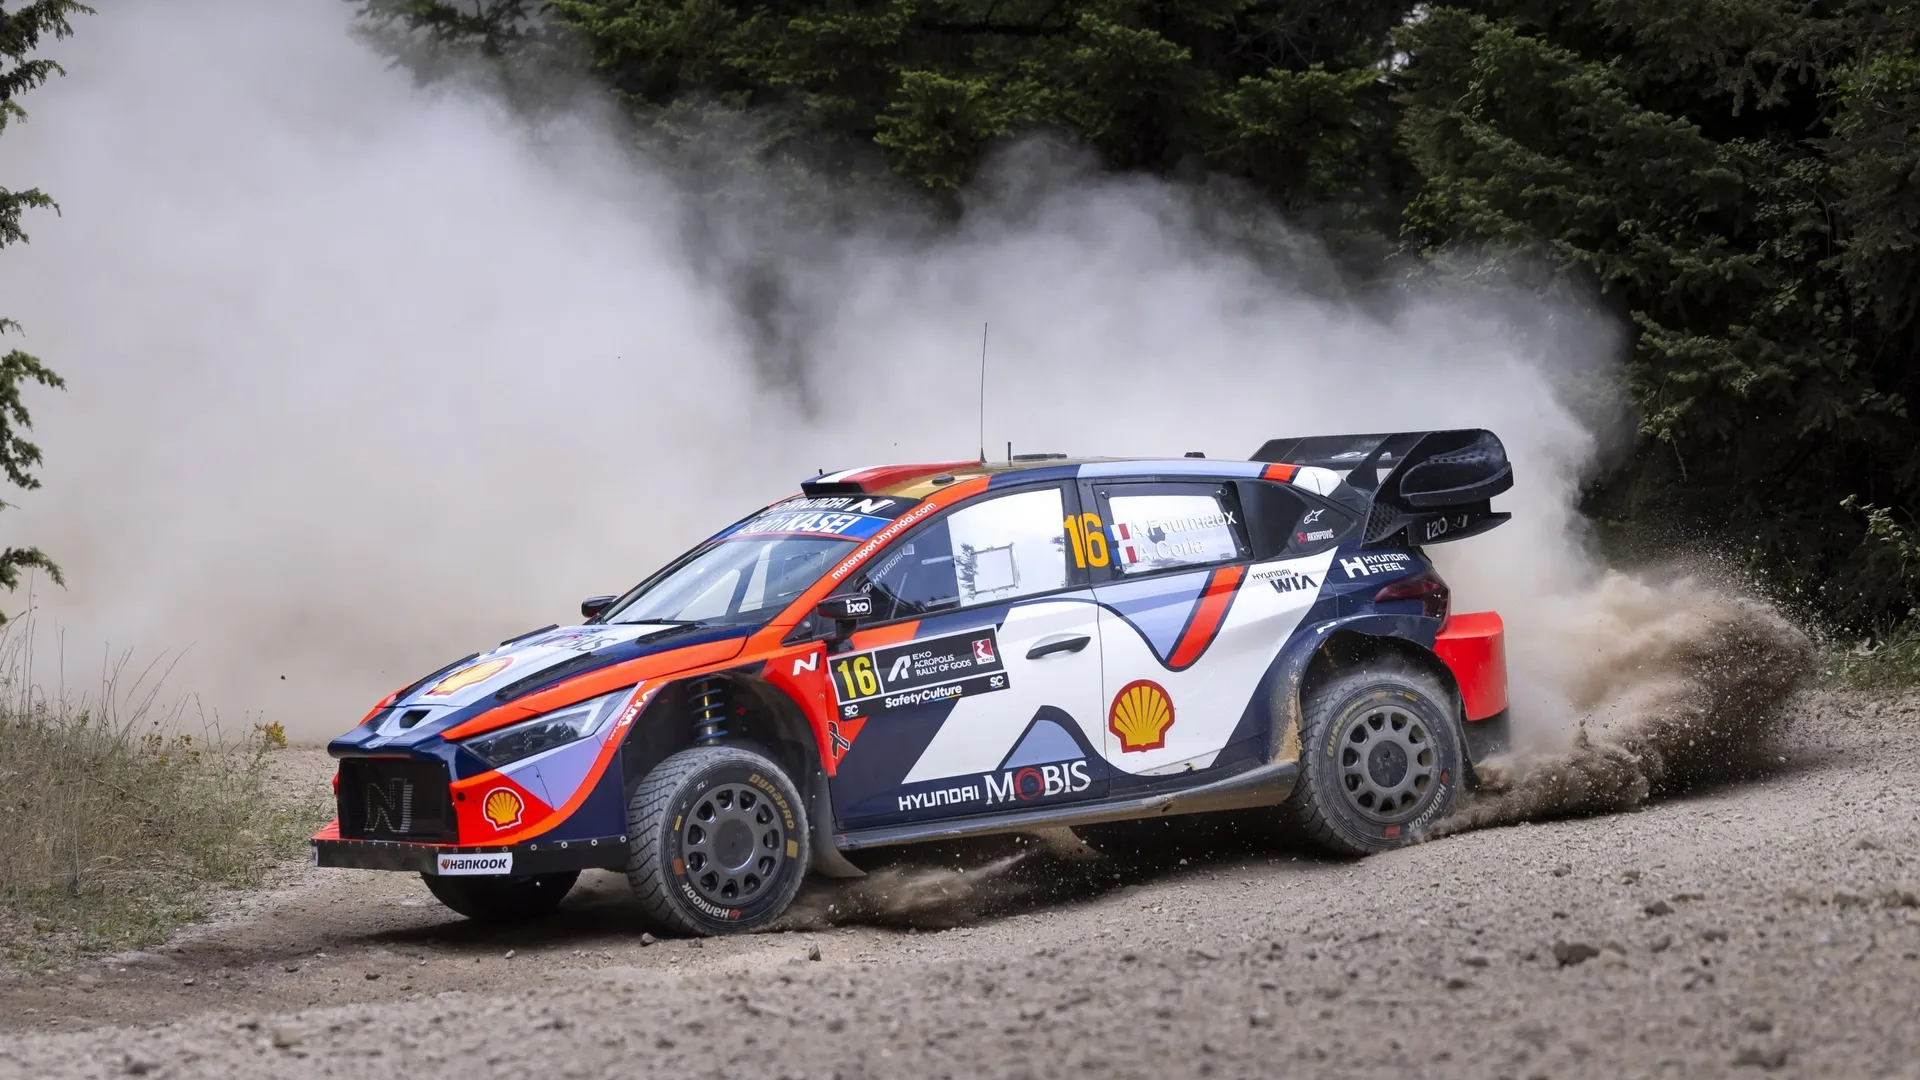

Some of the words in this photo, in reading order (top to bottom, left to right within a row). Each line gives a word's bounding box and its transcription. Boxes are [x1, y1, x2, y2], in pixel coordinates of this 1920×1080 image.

[845, 498, 896, 515] N
[831, 500, 937, 581] motorsport.hyundai.com
[1063, 512, 1110, 569] 16
[872, 551, 903, 584] HYUNDAI
[1364, 553, 1410, 565] HYUNDAI
[1251, 568, 1292, 580] HYUNDAI
[1369, 562, 1406, 574] STEEL
[845, 599, 869, 614] ixo
[792, 652, 820, 677] N
[912, 651, 932, 661] EKO
[914, 654, 955, 668] ACROPOLIS
[915, 665, 938, 677] RALLY
[938, 664, 950, 673] OF
[949, 658, 972, 671] GODS
[837, 655, 877, 699] 16
[989, 675, 1005, 688] SC
[885, 684, 963, 708] SafetyCulture
[844, 704, 859, 717] SC
[898, 785, 980, 812] HYUNDAI
[983, 760, 1092, 805] MOBIS
